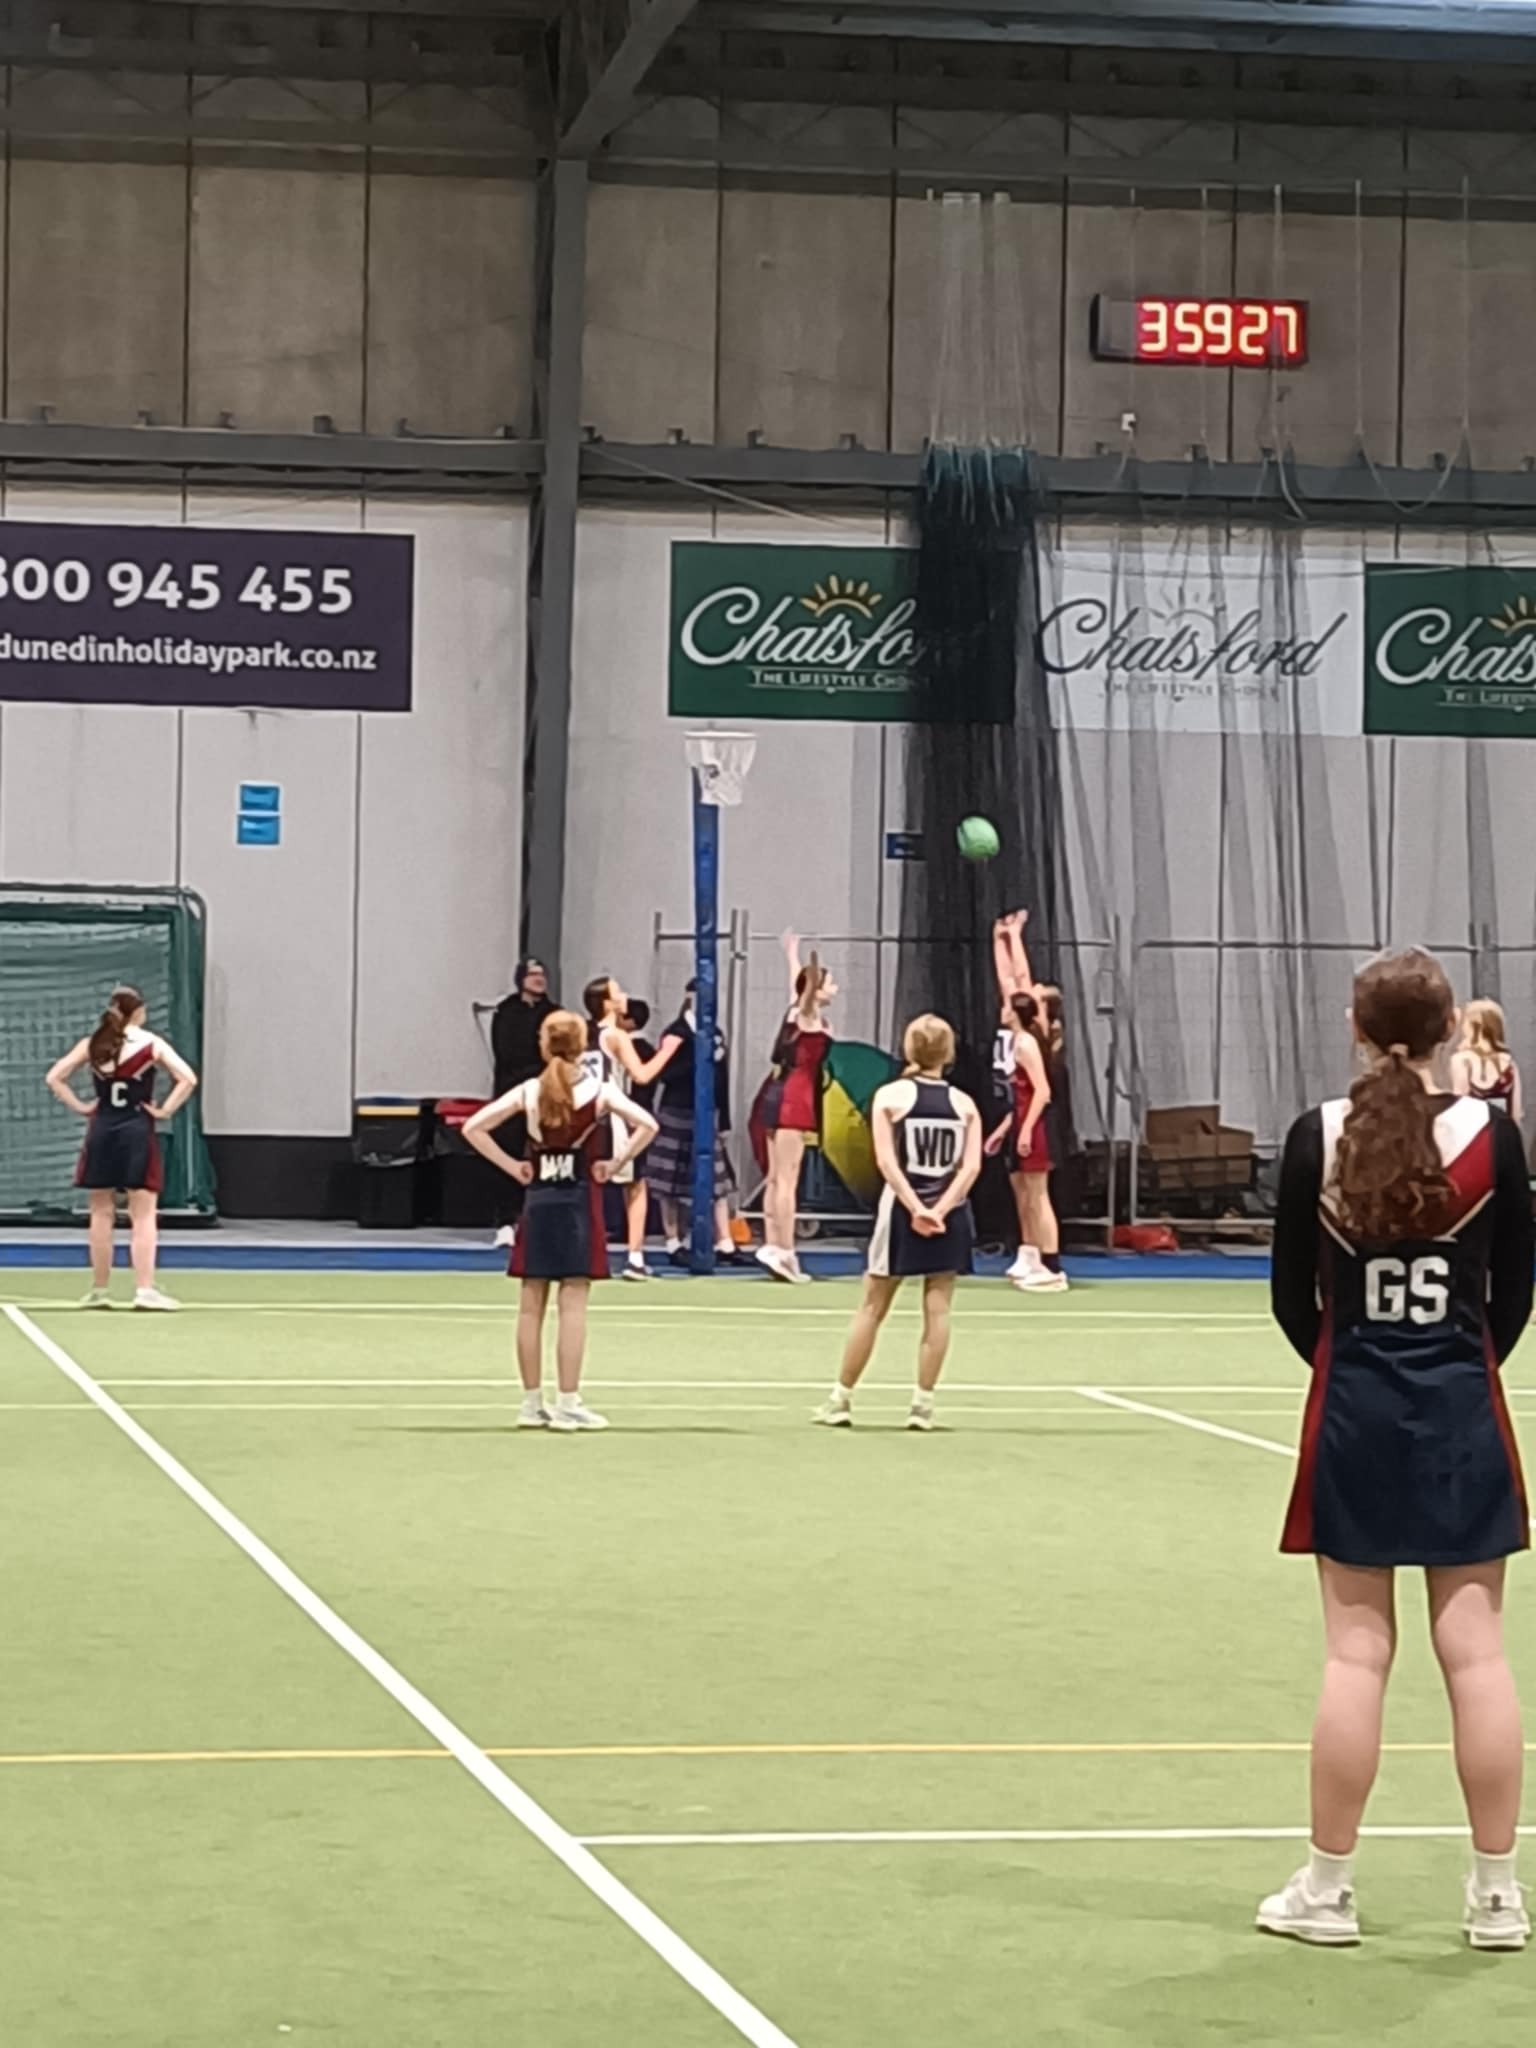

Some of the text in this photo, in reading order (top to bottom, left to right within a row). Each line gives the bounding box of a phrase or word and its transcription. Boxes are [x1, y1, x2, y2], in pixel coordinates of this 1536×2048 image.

[1141, 302, 1297, 355] 35927
[0, 557, 352, 613] 00 945 455
[0, 633, 377, 673] dunedinholidaypark.co.nz
[680, 586, 922, 672] Chatsfo
[1040, 598, 1348, 680] Chatsford
[1375, 607, 1536, 689] Chats
[111, 1081, 128, 1107] C
[914, 1126, 956, 1168] WD
[1365, 1256, 1449, 1325] GS
